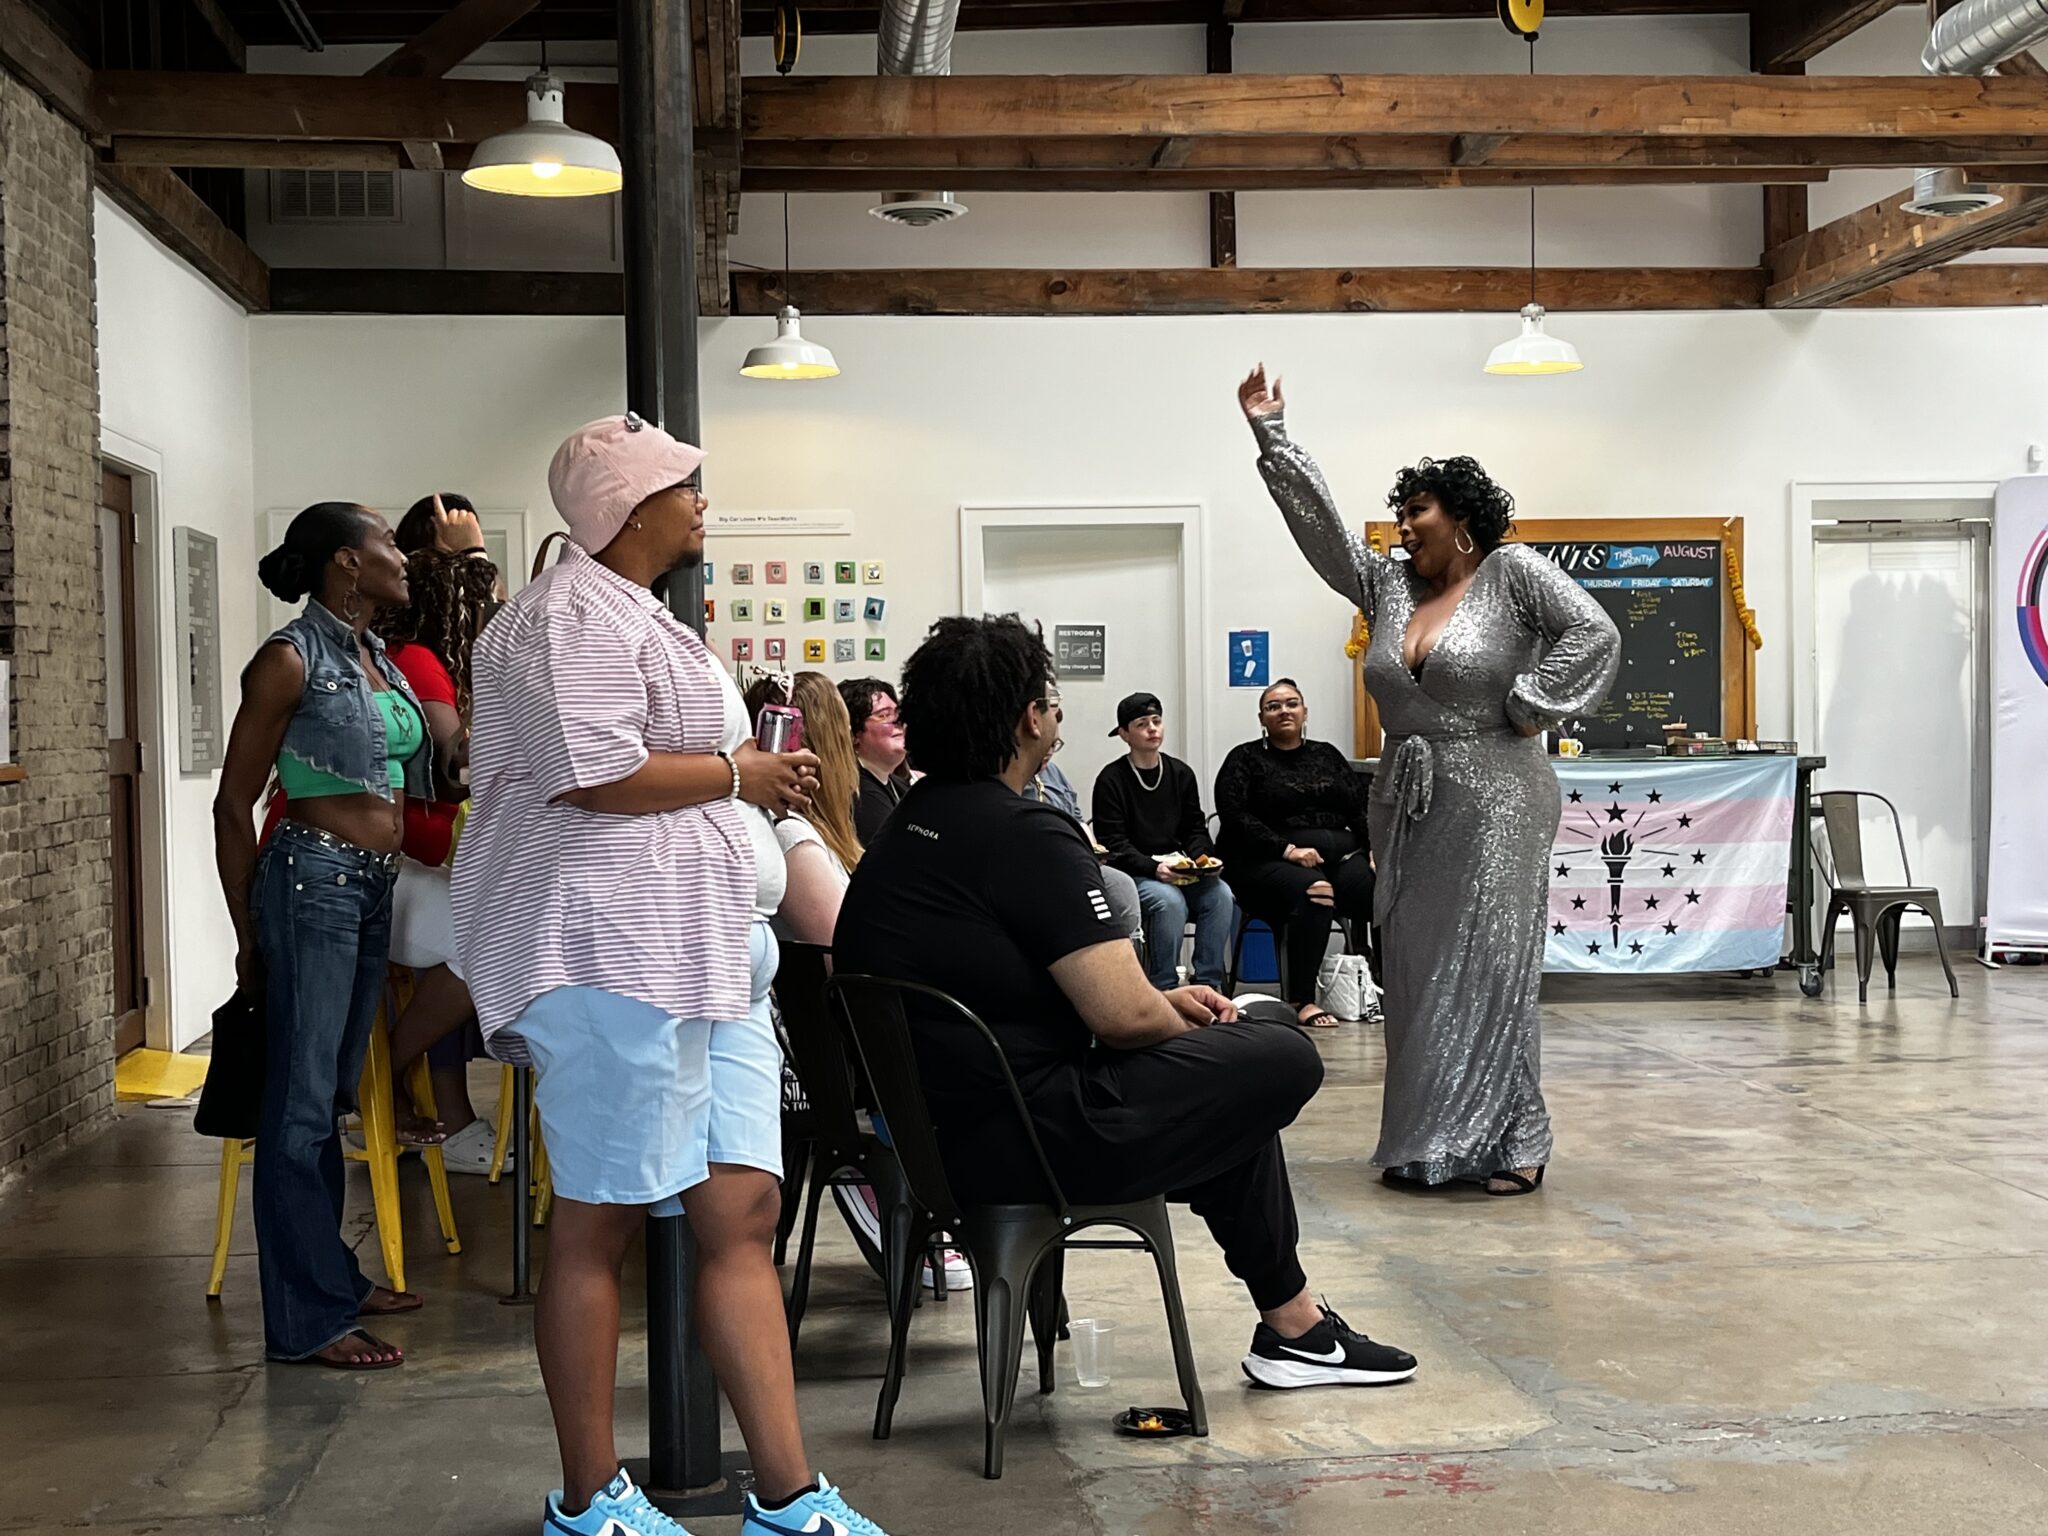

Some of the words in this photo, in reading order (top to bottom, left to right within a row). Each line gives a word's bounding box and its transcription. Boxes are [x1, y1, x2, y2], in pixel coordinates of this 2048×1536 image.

[1614, 548, 1633, 561] THIS
[1663, 545, 1716, 560] AUGUST
[1619, 551, 1654, 568] MONTH
[1582, 579, 1623, 588] THURSDAY
[1631, 578, 1661, 587] FRIDAY
[1671, 577, 1711, 587] SATURDAY
